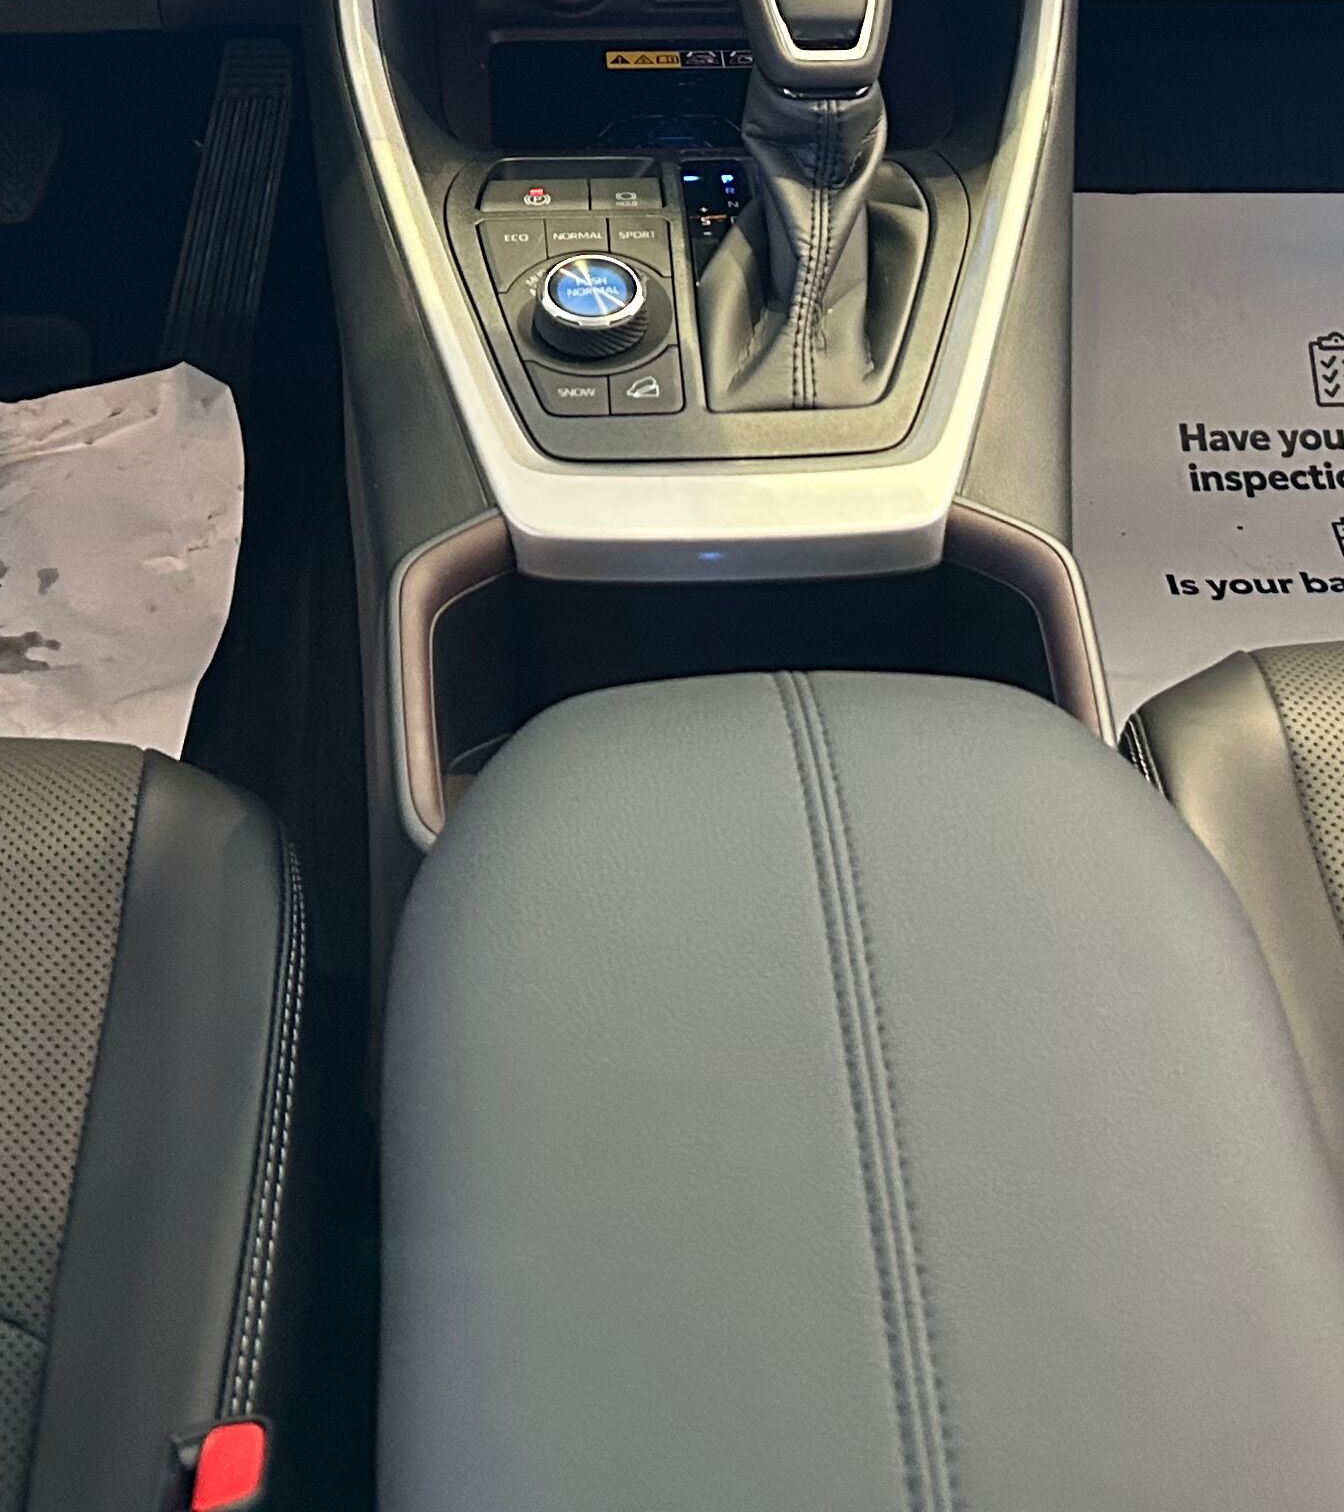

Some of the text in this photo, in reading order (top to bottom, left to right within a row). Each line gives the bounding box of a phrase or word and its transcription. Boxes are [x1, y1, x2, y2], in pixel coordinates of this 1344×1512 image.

[504, 233, 529, 242] ECO
[552, 232, 603, 241] NORMAL
[618, 230, 656, 240] SPORT
[558, 387, 596, 397] SNOW
[1178, 422, 1271, 454] Have
[1165, 572, 1200, 596] Is
[1207, 574, 1294, 601] your
